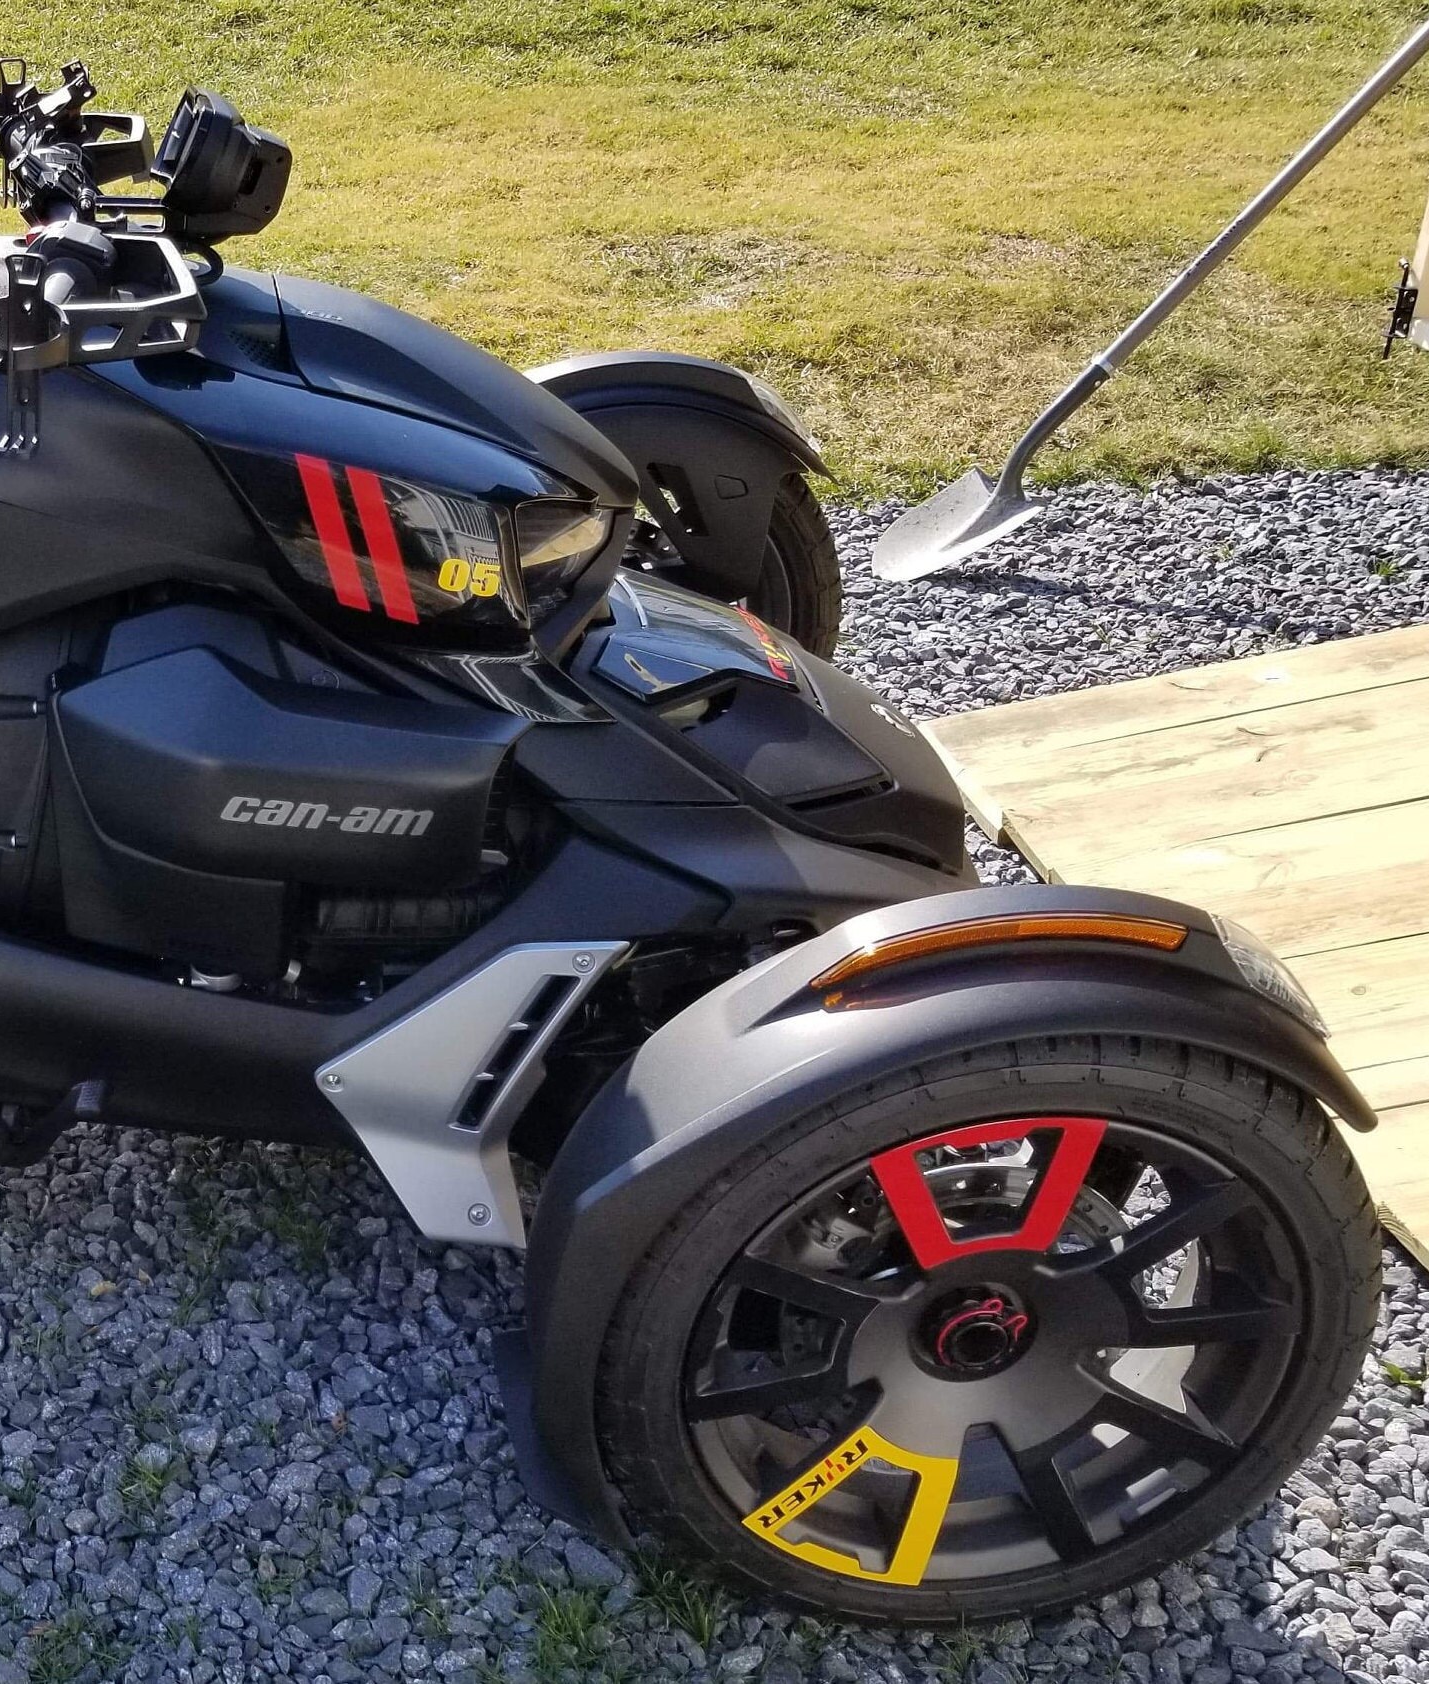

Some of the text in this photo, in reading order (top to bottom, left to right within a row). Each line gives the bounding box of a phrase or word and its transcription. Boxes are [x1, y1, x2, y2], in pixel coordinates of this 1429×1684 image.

[437, 558, 501, 597] 05
[220, 796, 434, 836] can-am
[757, 1439, 869, 1529] RYKER
